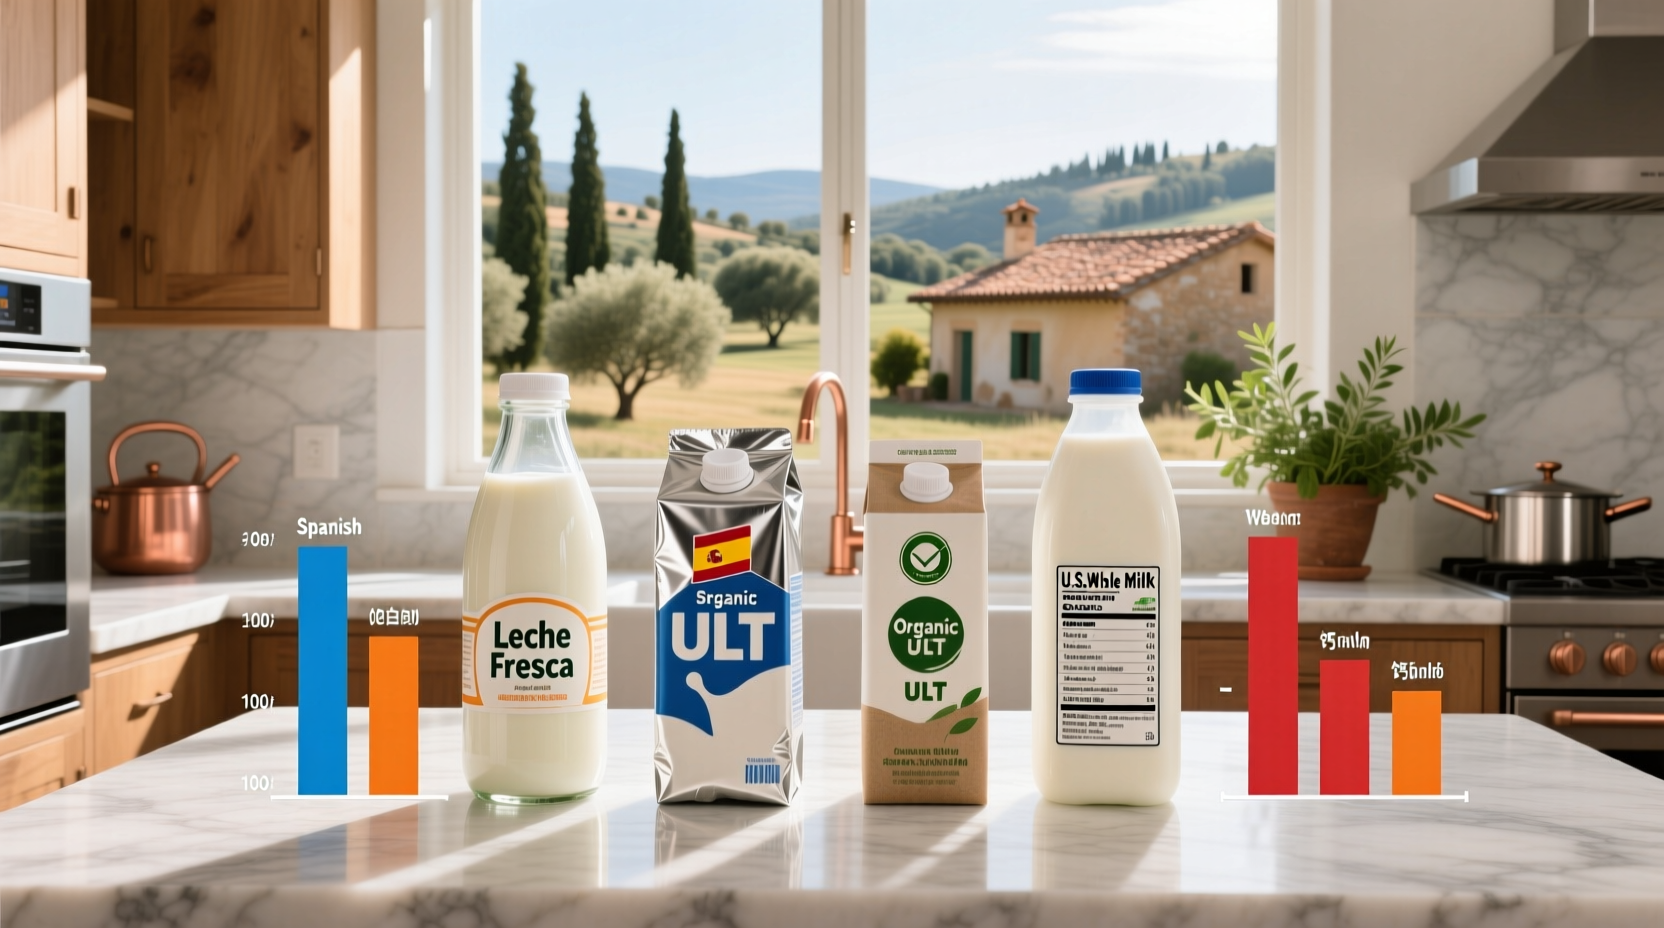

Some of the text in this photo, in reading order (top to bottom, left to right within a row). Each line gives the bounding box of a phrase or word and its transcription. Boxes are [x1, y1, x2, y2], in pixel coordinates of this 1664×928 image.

[1124, 571, 1156, 589] Milk
[696, 590, 757, 609] Srganic
[494, 620, 571, 649] Leche
[671, 612, 775, 661] ULT
[893, 617, 959, 639] Organic
[907, 638, 946, 656] ULT
[490, 652, 574, 679] Fresca
[904, 681, 947, 702] ULT
